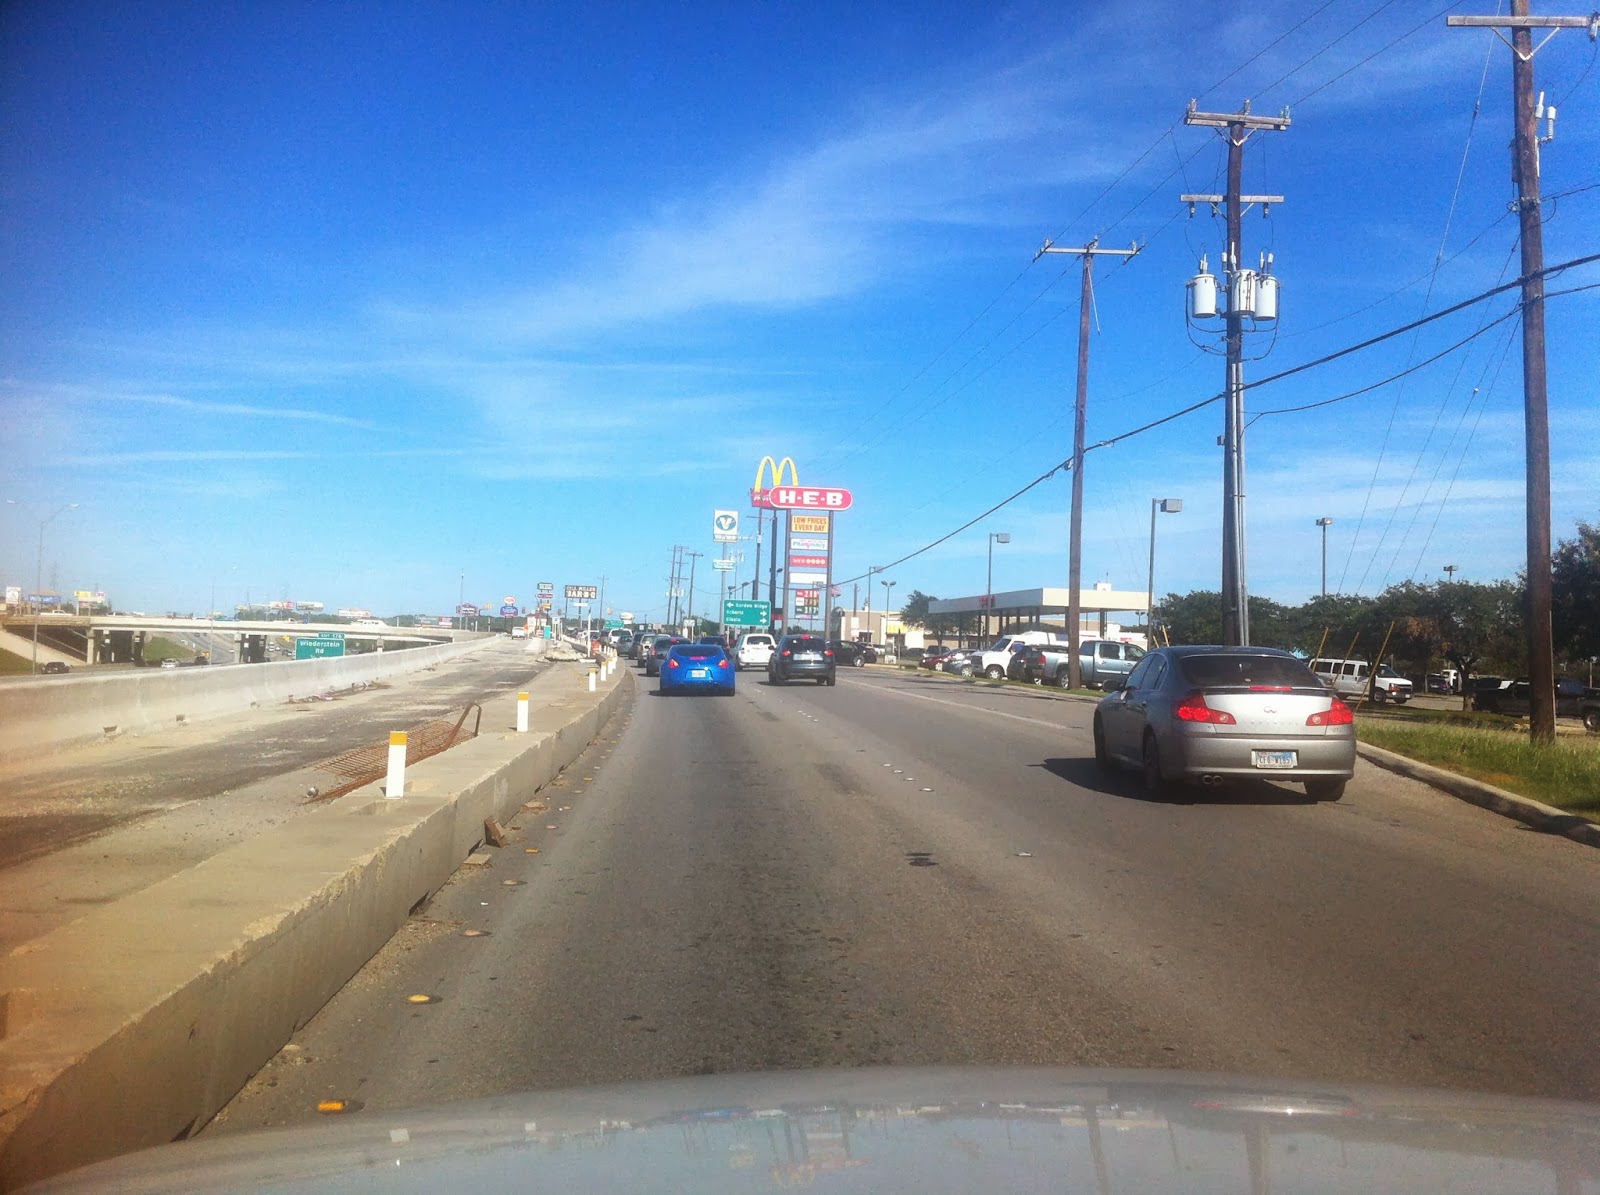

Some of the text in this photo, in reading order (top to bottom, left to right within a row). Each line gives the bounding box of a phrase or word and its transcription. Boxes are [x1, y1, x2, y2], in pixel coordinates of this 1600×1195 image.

[793, 516, 827, 525] LOW PRICES
[794, 523, 825, 532] EVERY DAY
[300, 640, 340, 648] Wiederstein
